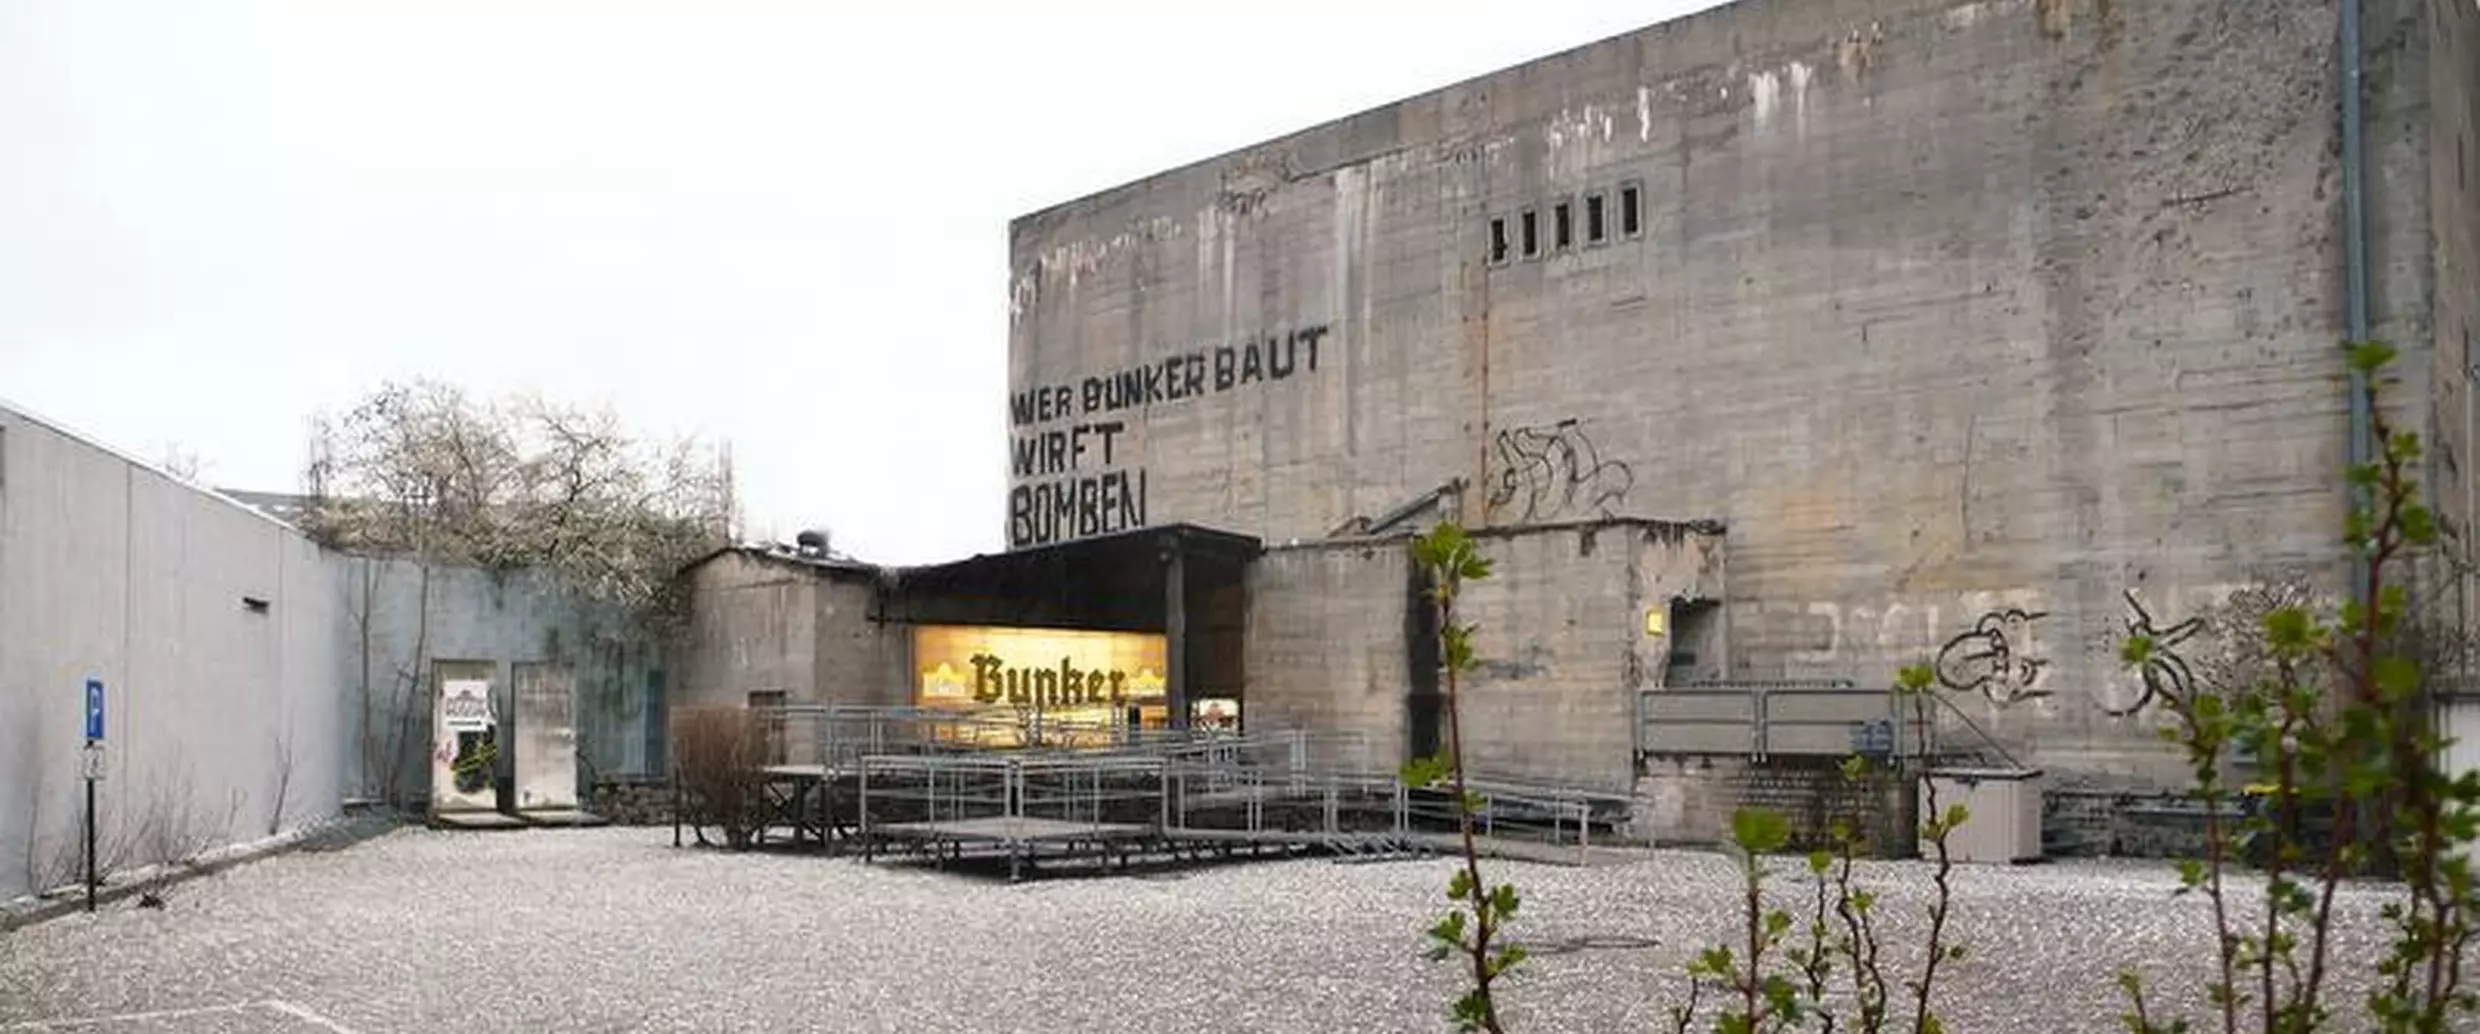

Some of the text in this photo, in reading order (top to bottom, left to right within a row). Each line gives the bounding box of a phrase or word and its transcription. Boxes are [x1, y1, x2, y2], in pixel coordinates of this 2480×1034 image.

[1009, 326, 1328, 426] WER BUNKER BAUT
[1009, 421, 1124, 477] WIRFT
[1008, 468, 1146, 548] BOMBEN
[969, 653, 1128, 707] Bunker
